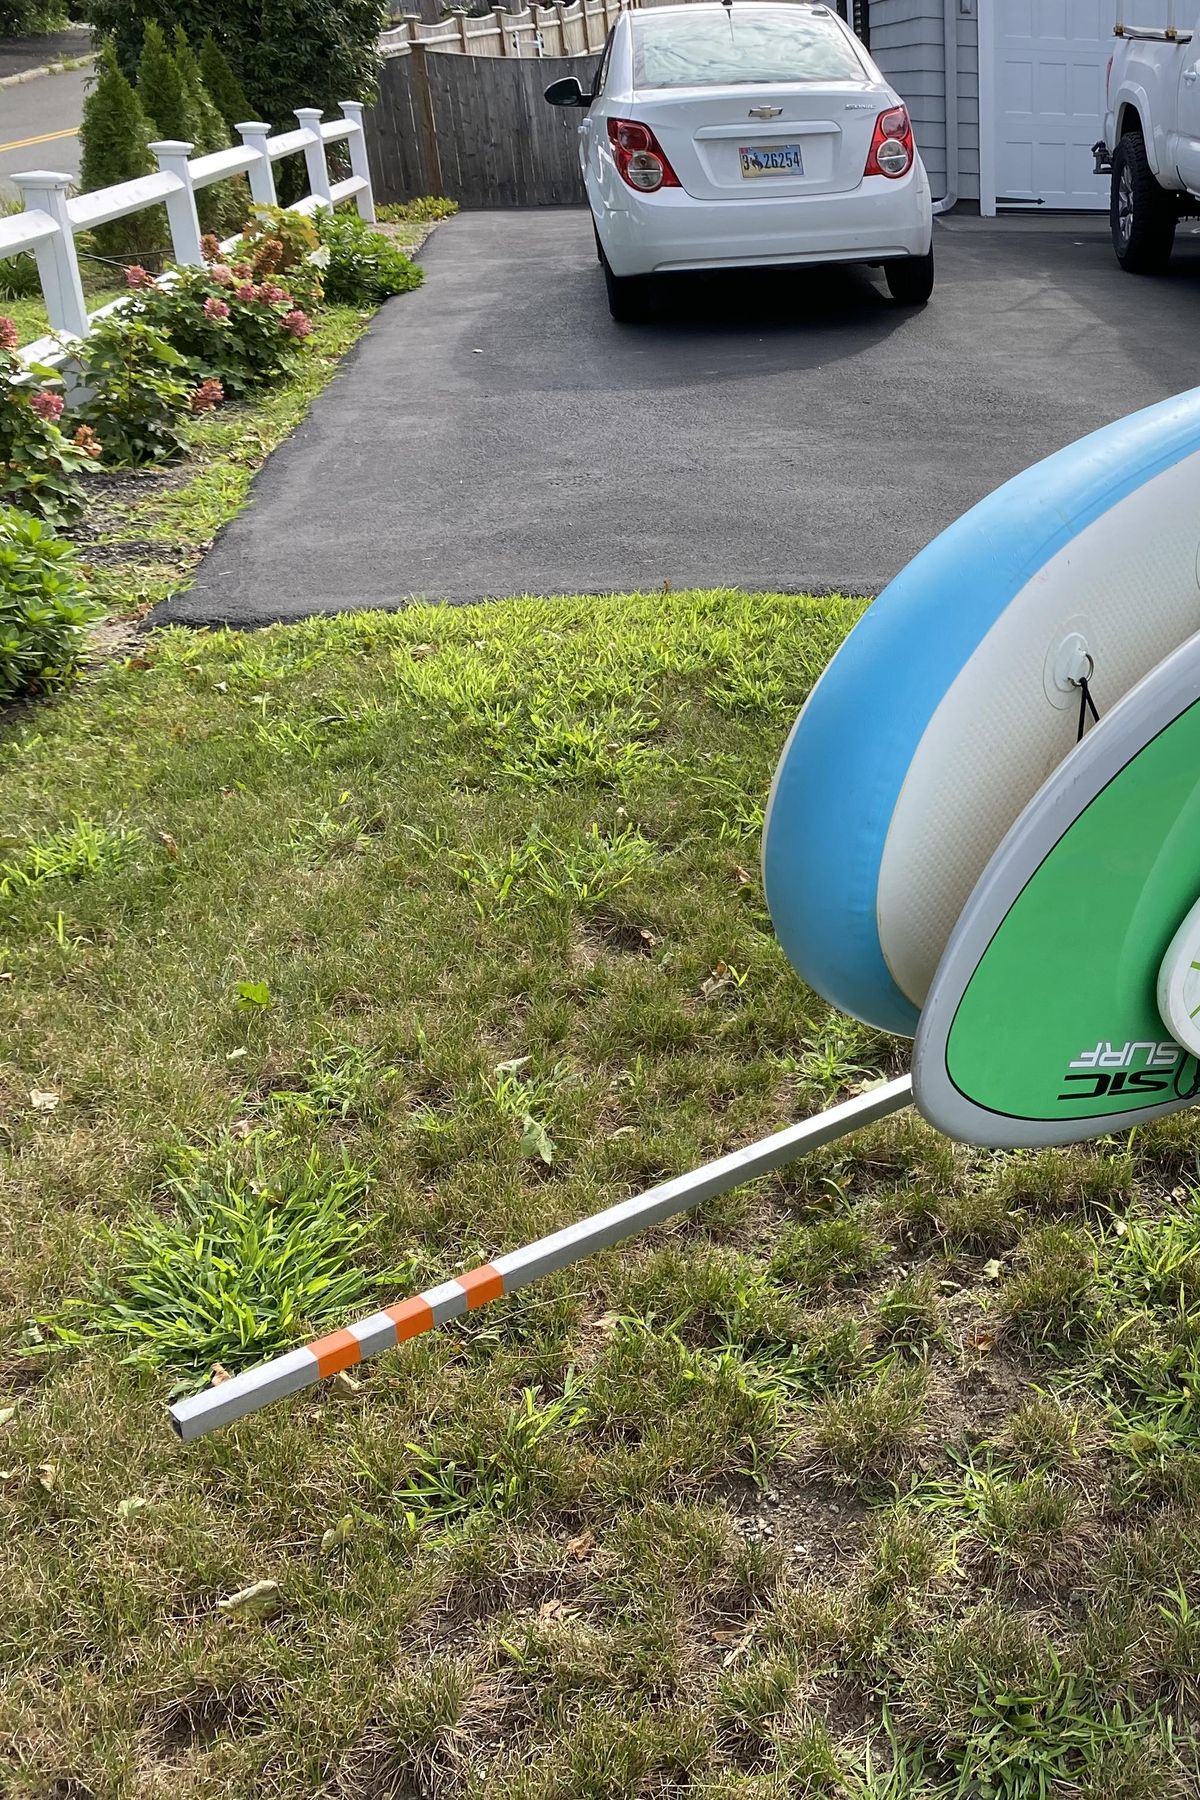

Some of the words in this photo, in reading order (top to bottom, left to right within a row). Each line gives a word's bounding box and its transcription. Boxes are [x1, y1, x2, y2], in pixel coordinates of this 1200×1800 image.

[742, 154, 750, 170] 3
[763, 152, 800, 169] 26254
[1069, 1041, 1180, 1068] SURF
[1056, 1069, 1174, 1101] SIC
